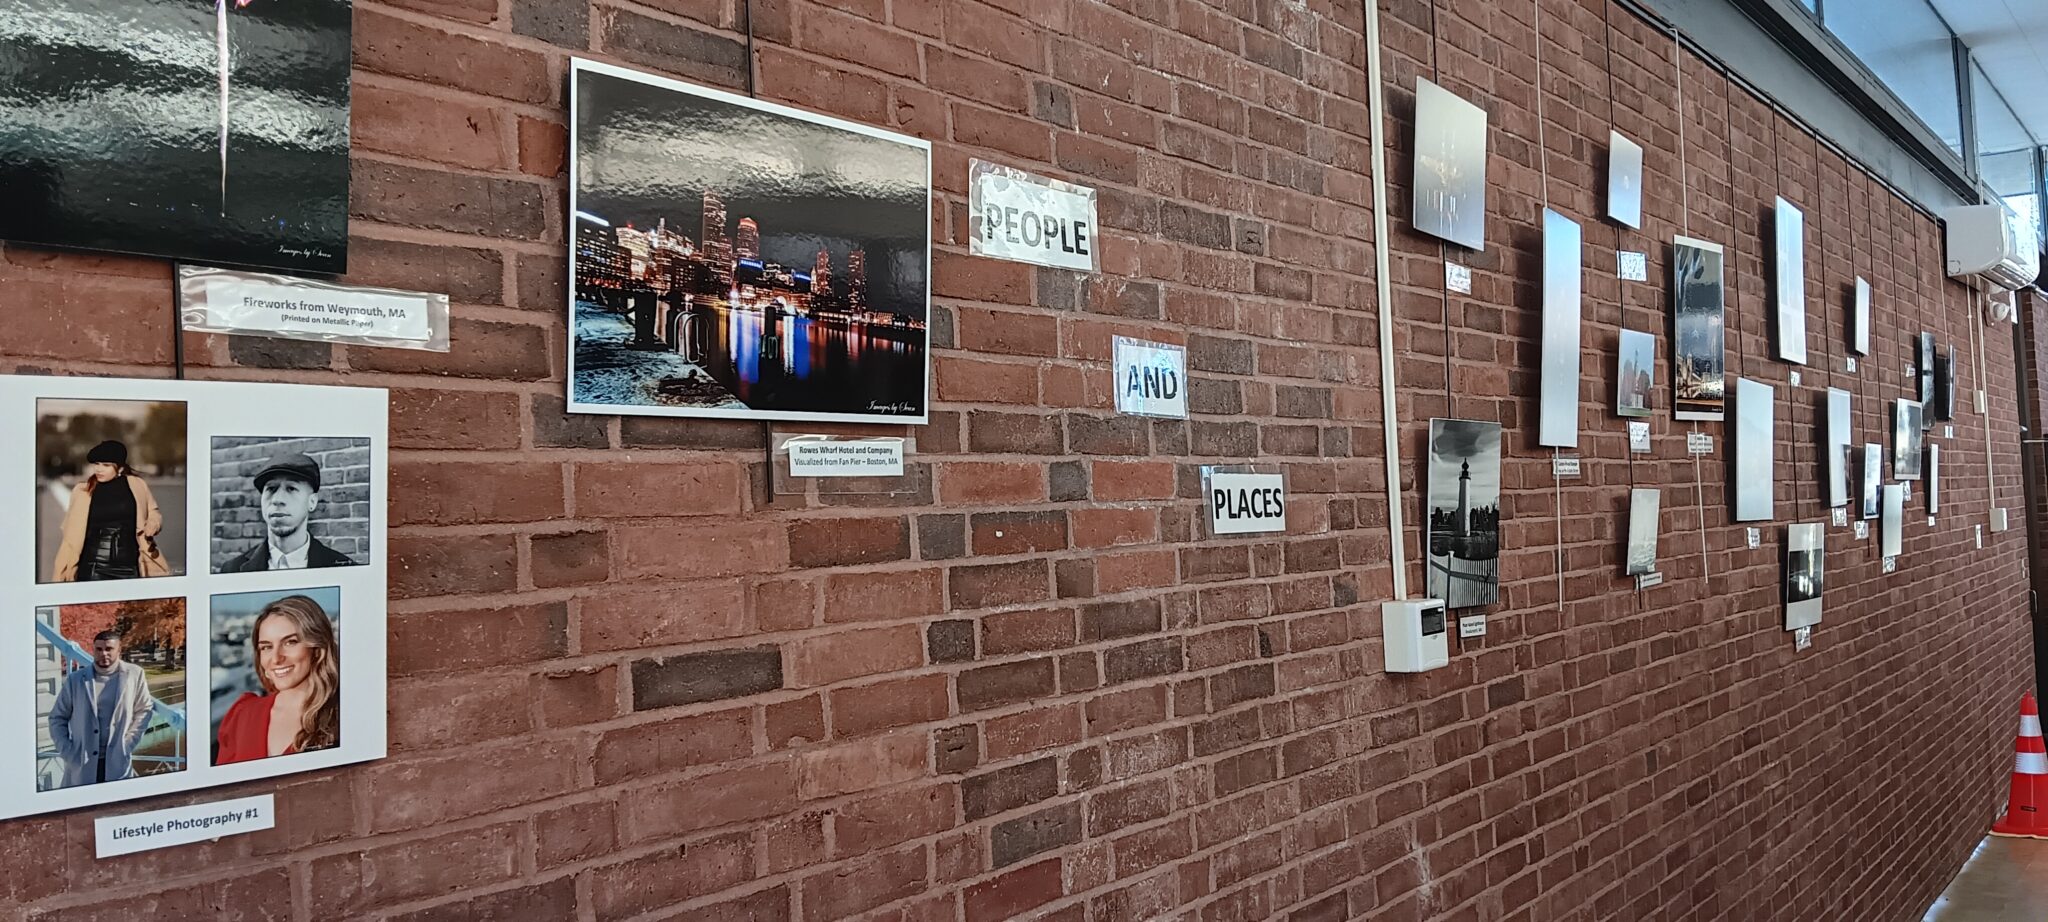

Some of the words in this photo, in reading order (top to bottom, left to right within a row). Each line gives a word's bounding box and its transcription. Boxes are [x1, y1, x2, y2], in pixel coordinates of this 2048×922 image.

[986, 202, 1089, 255] PEOPLE
[243, 297, 297, 311] Fireworks
[299, 301, 325, 313] from
[327, 303, 386, 319] Weymouth,
[388, 307, 406, 319] MA
[281, 314, 309, 325] (Printed
[322, 316, 350, 327] Metallic
[351, 318, 374, 329] Paper)
[1126, 364, 1178, 400] AND
[794, 458, 823, 466] Visualized
[824, 458, 838, 466] from
[866, 458, 887, 466] Boston,
[888, 457, 898, 465] MA
[799, 446, 819, 454] Rowes
[819, 446, 838, 454] Wharf
[838, 446, 855, 454] Hotel
[855, 446, 867, 454] and
[867, 446, 893, 456] Company
[1213, 488, 1284, 520] PLACES
[113, 822, 164, 840] Lifestyle
[167, 810, 243, 832] Photography
[245, 807, 259, 820] #1
